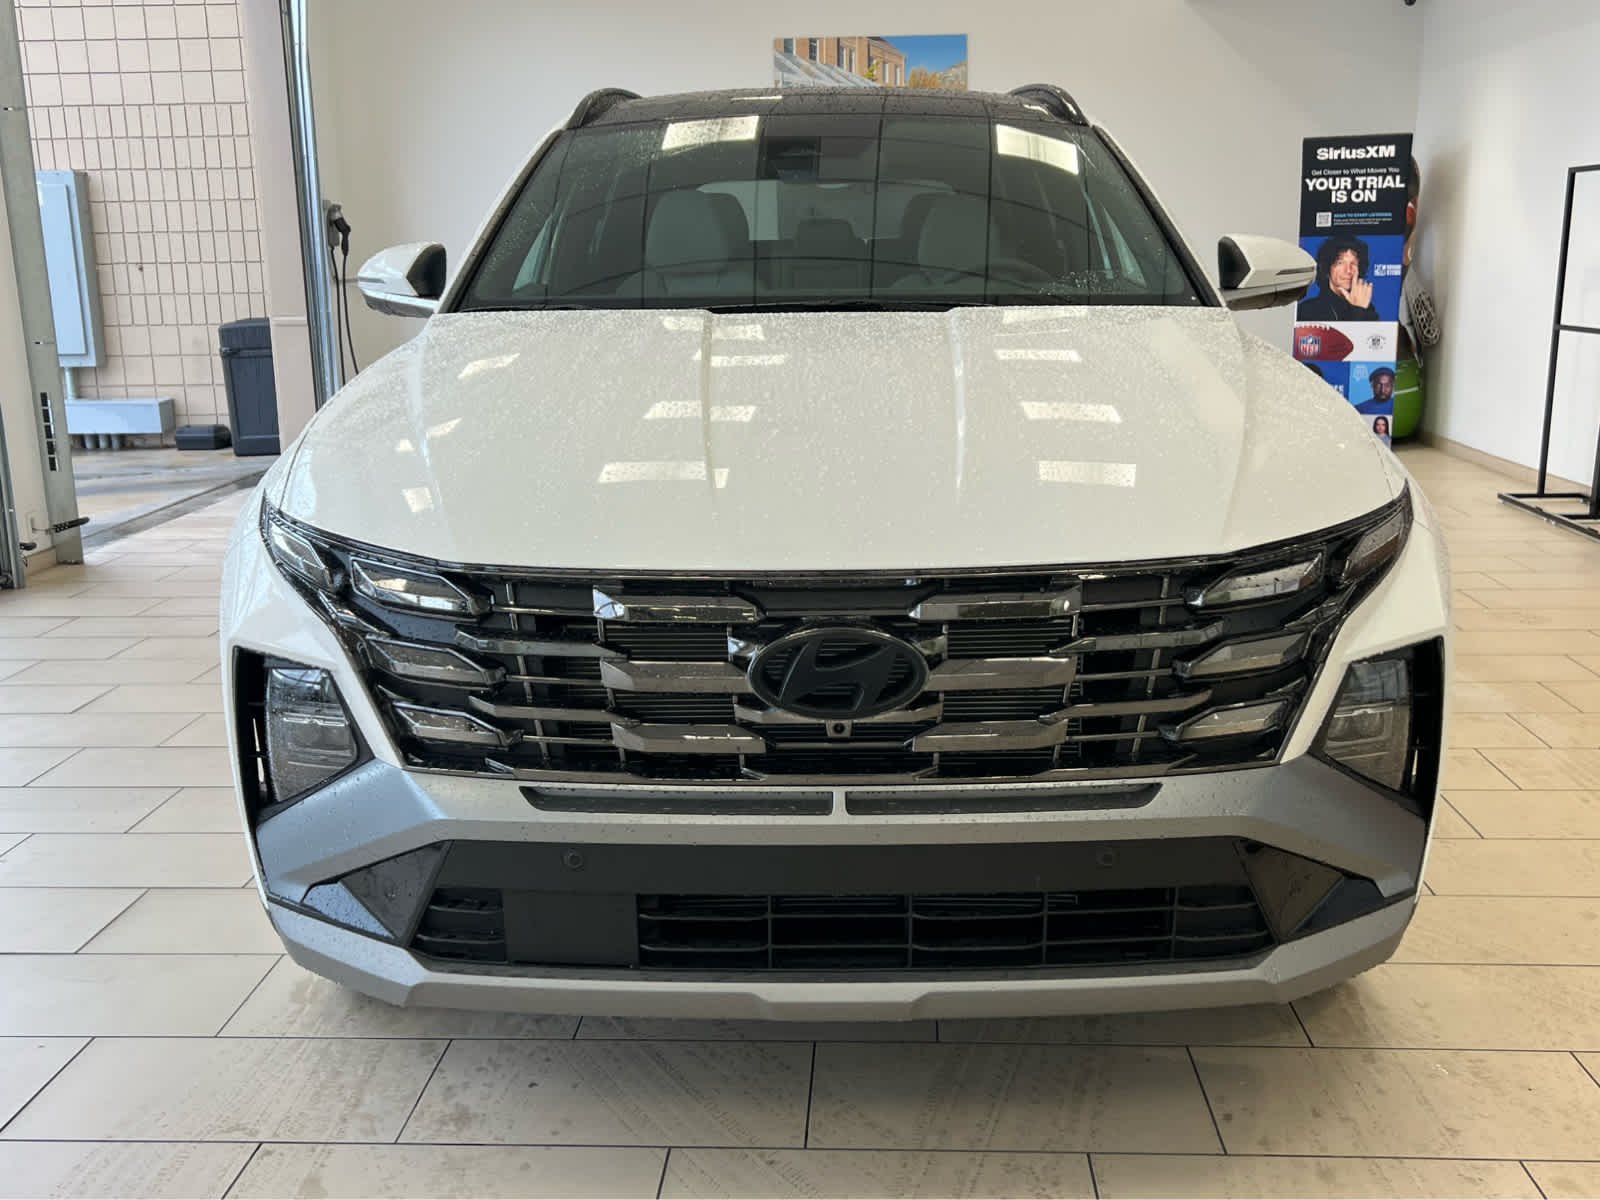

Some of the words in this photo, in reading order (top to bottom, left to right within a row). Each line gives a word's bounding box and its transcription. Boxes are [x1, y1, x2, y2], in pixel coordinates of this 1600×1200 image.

[1317, 144, 1396, 160] SiriusXM
[1305, 177, 1351, 191] YOUR
[1355, 175, 1405, 189] TRIAL
[1331, 190, 1347, 203] IS
[1351, 189, 1377, 203] ON
